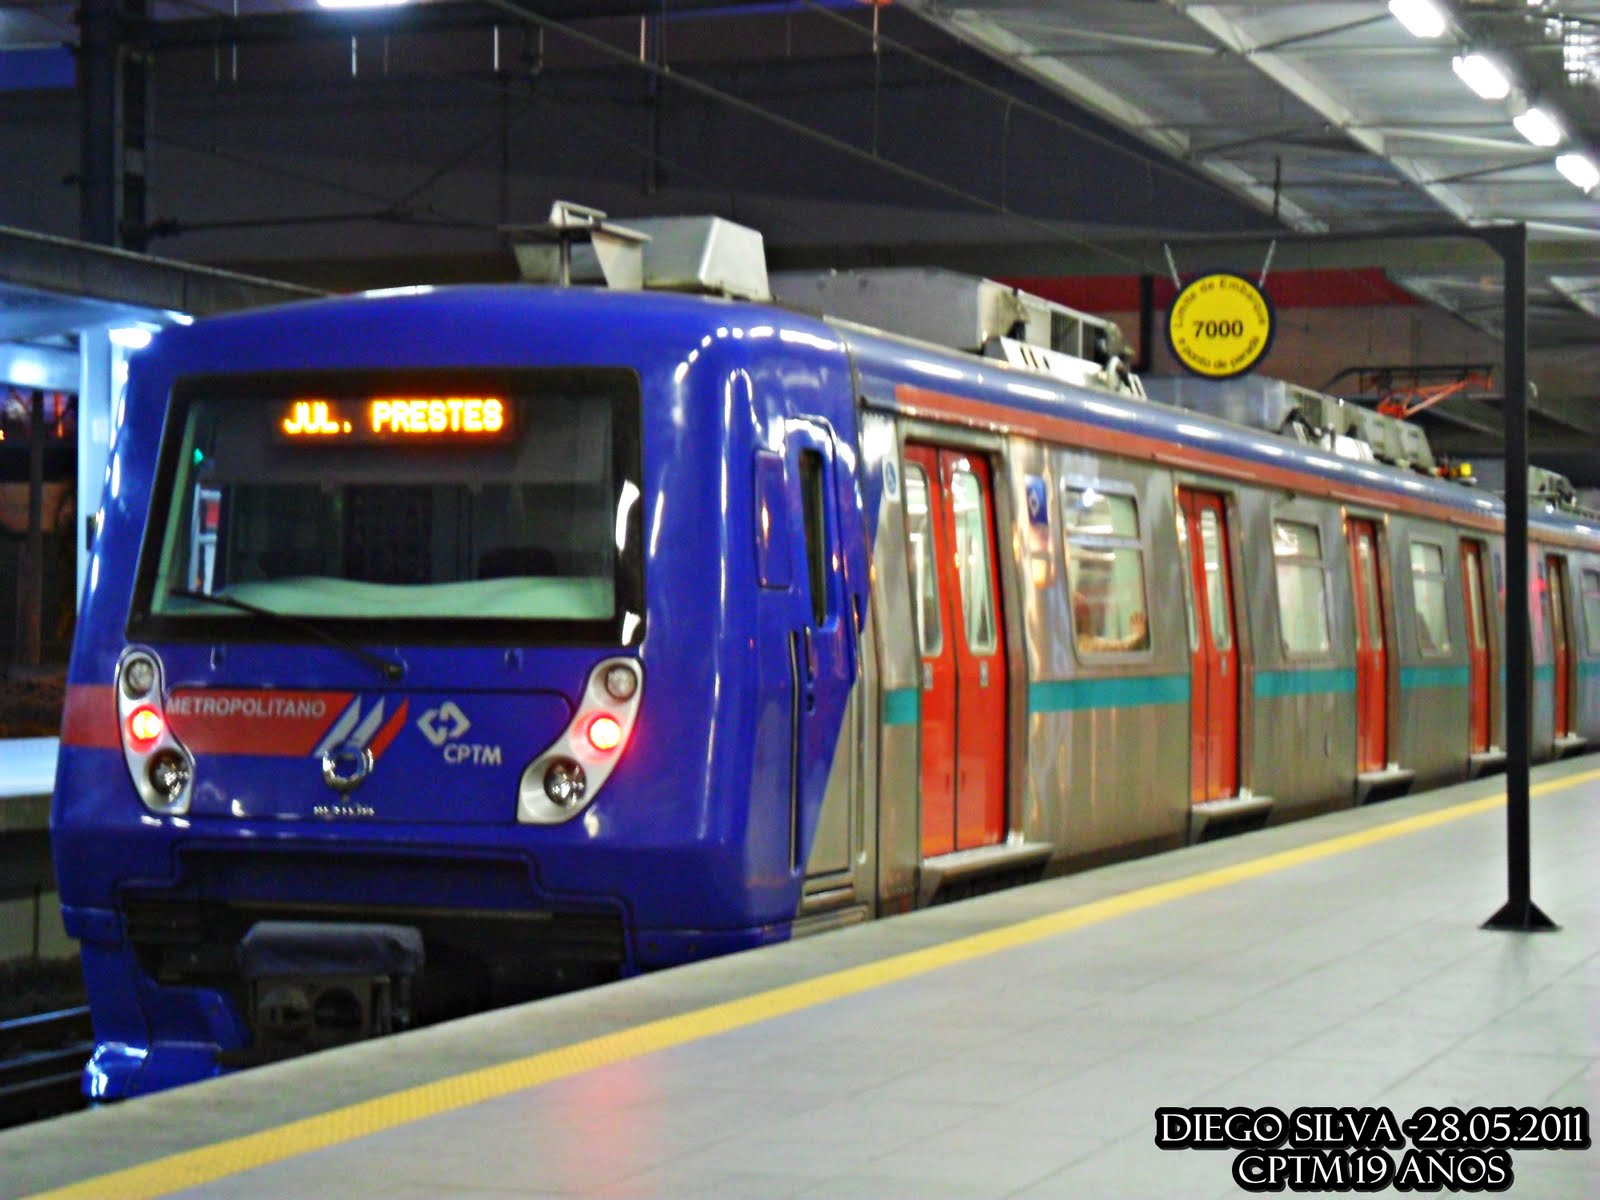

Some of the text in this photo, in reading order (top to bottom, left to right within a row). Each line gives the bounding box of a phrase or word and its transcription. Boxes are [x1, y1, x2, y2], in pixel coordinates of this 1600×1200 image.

[1192, 319, 1244, 339] 7000
[283, 399, 504, 434] JUL. PRESTES
[164, 696, 327, 719] METROPOLITANO
[442, 743, 503, 766] CPTM
